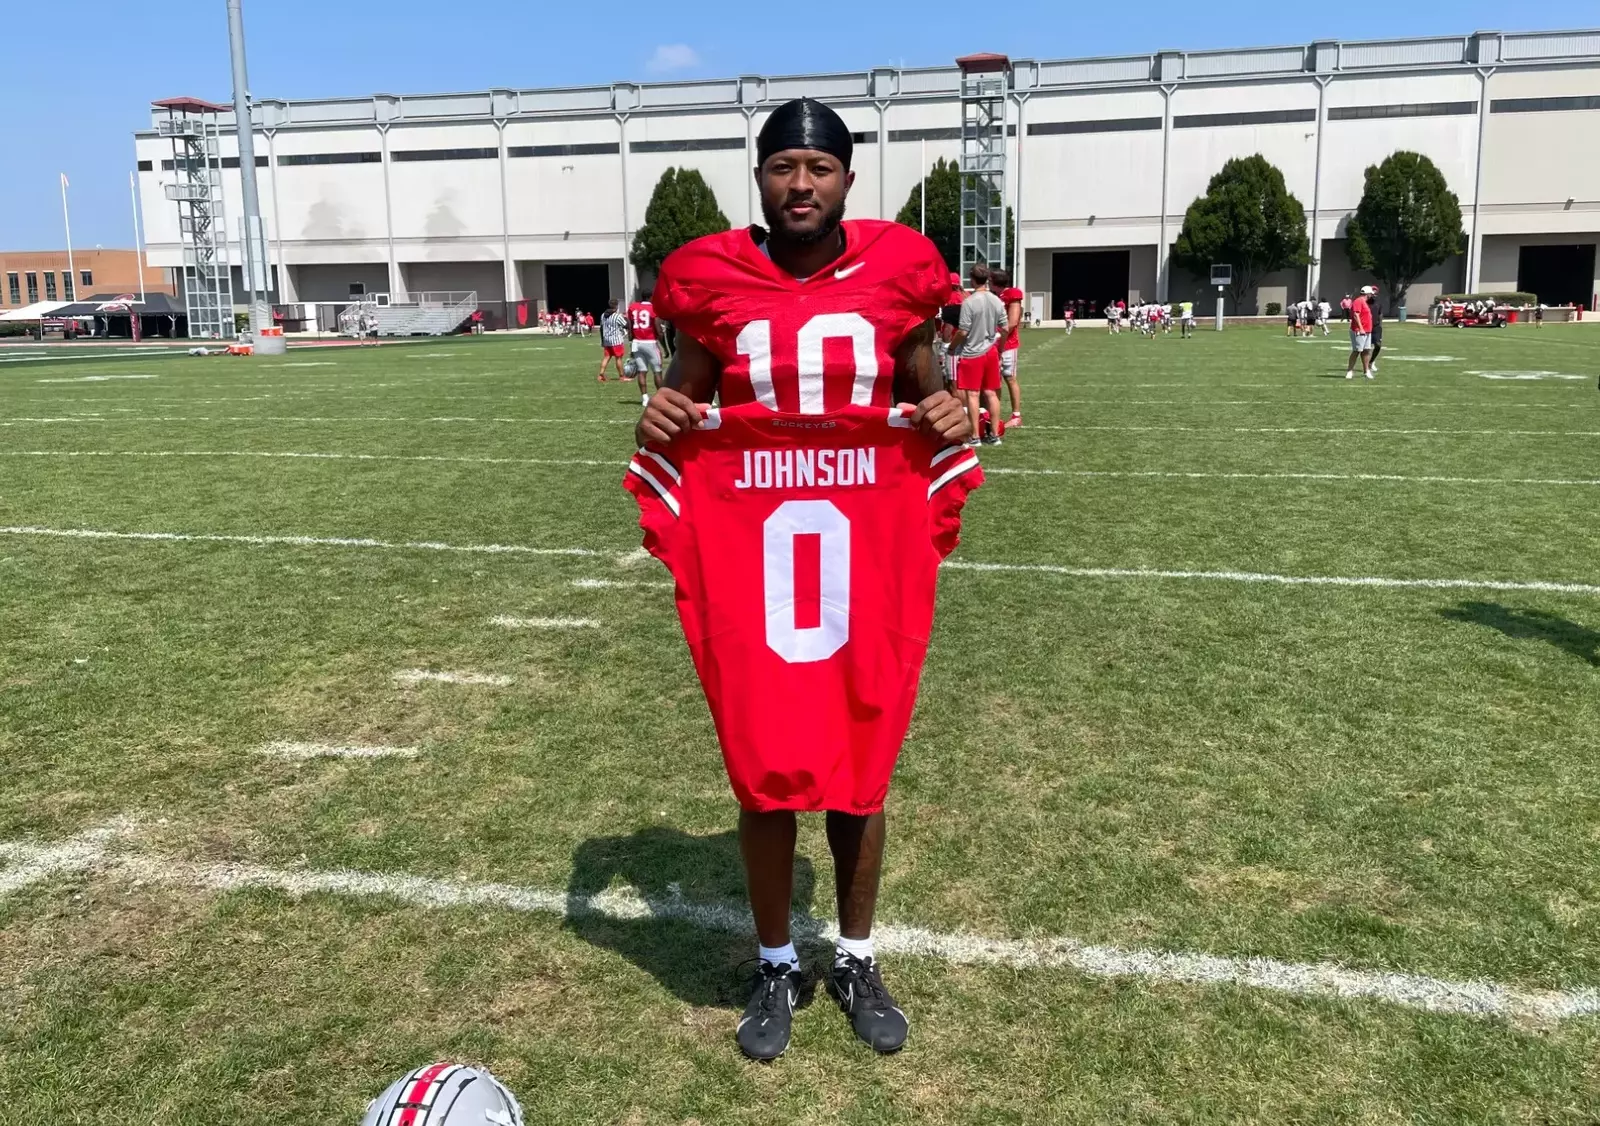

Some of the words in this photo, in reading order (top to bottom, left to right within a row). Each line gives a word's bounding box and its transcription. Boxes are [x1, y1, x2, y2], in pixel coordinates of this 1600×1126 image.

[632, 309, 650, 329] 19
[736, 312, 878, 415] 10
[772, 419, 837, 428] BUCKEYES
[735, 447, 875, 488] JOHNSON
[763, 499, 851, 663] 0
